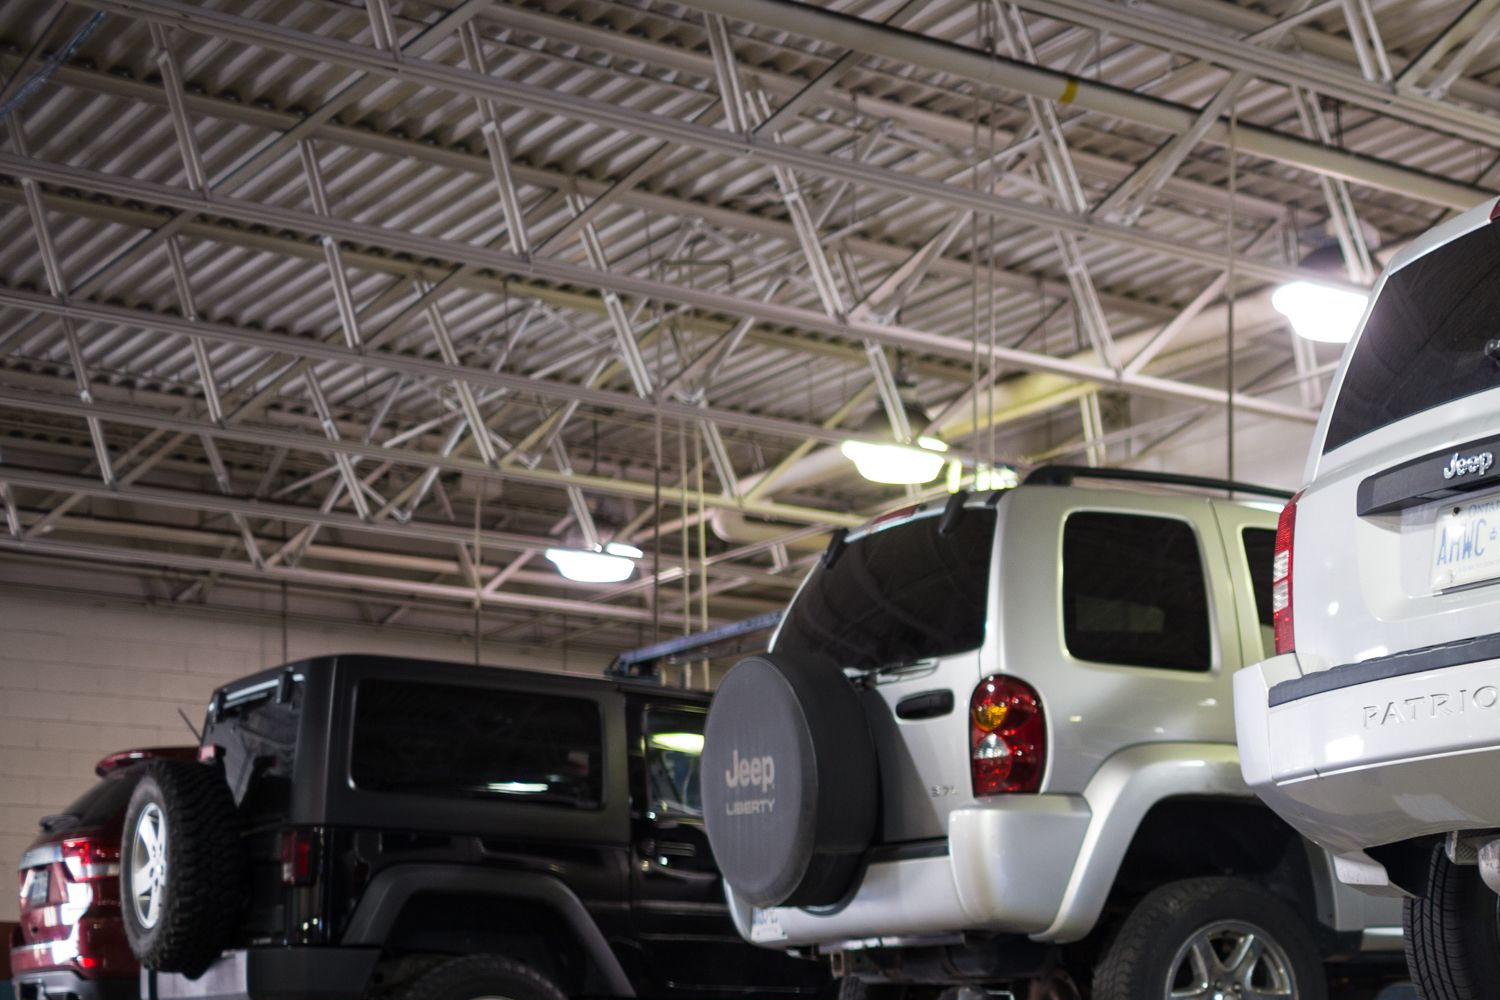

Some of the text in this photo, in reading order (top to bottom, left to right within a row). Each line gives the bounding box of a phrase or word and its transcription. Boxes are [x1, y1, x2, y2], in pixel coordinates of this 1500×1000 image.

[1443, 452, 1493, 480] Jeep
[725, 749, 775, 793] Jeep
[726, 798, 776, 816] LIBERTY
